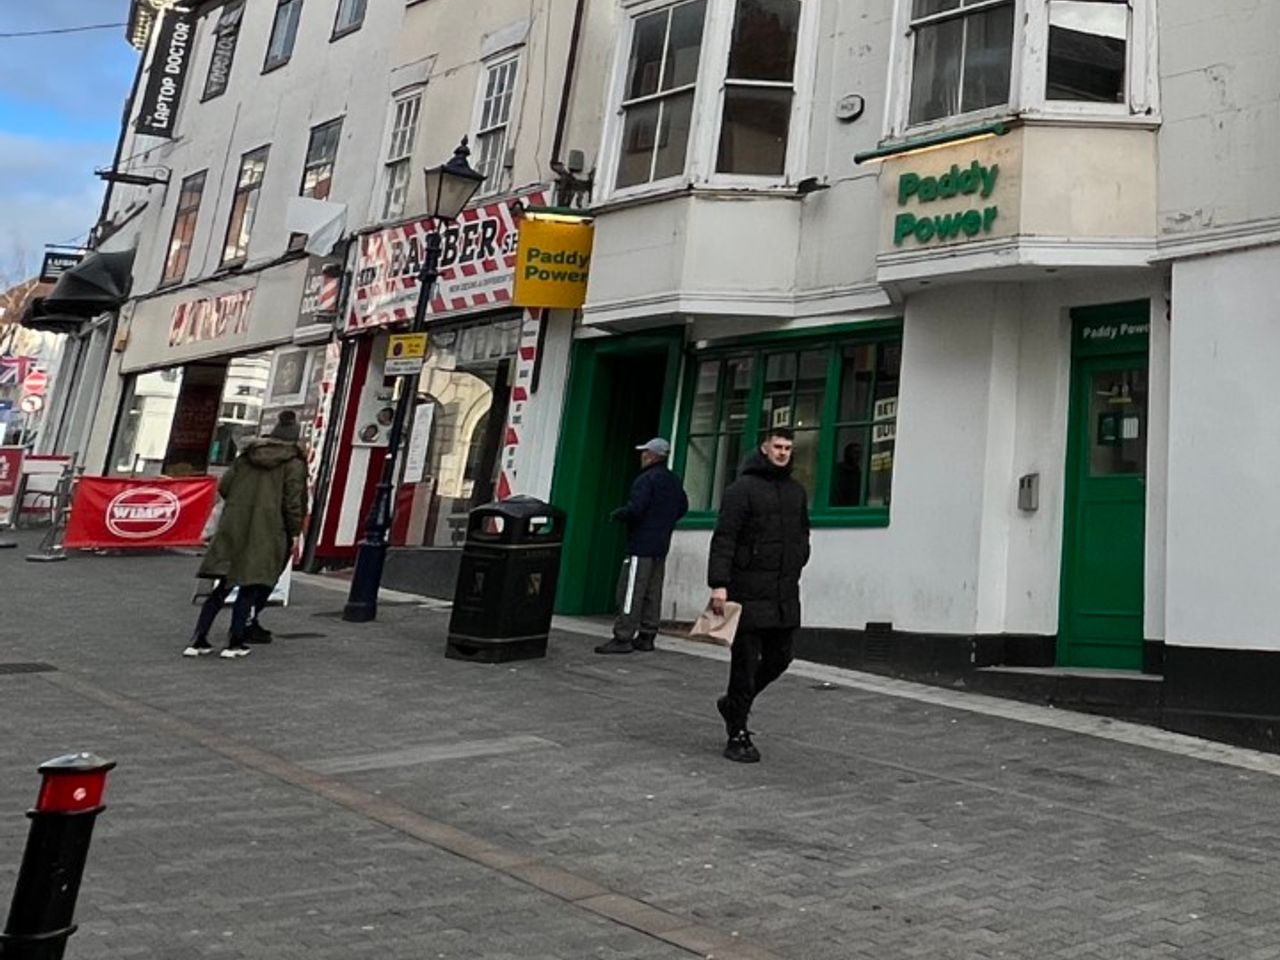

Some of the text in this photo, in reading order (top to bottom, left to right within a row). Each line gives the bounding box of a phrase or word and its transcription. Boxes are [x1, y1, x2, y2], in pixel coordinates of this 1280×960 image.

[152, 22, 190, 128] LAPTOP DOCTOR
[898, 160, 999, 206] Paddy
[894, 206, 998, 247] Power
[386, 219, 497, 278] BABER
[527, 247, 588, 268] Paddy
[1083, 325, 1118, 340] Paddy
[112, 505, 176, 519] WIMPY
